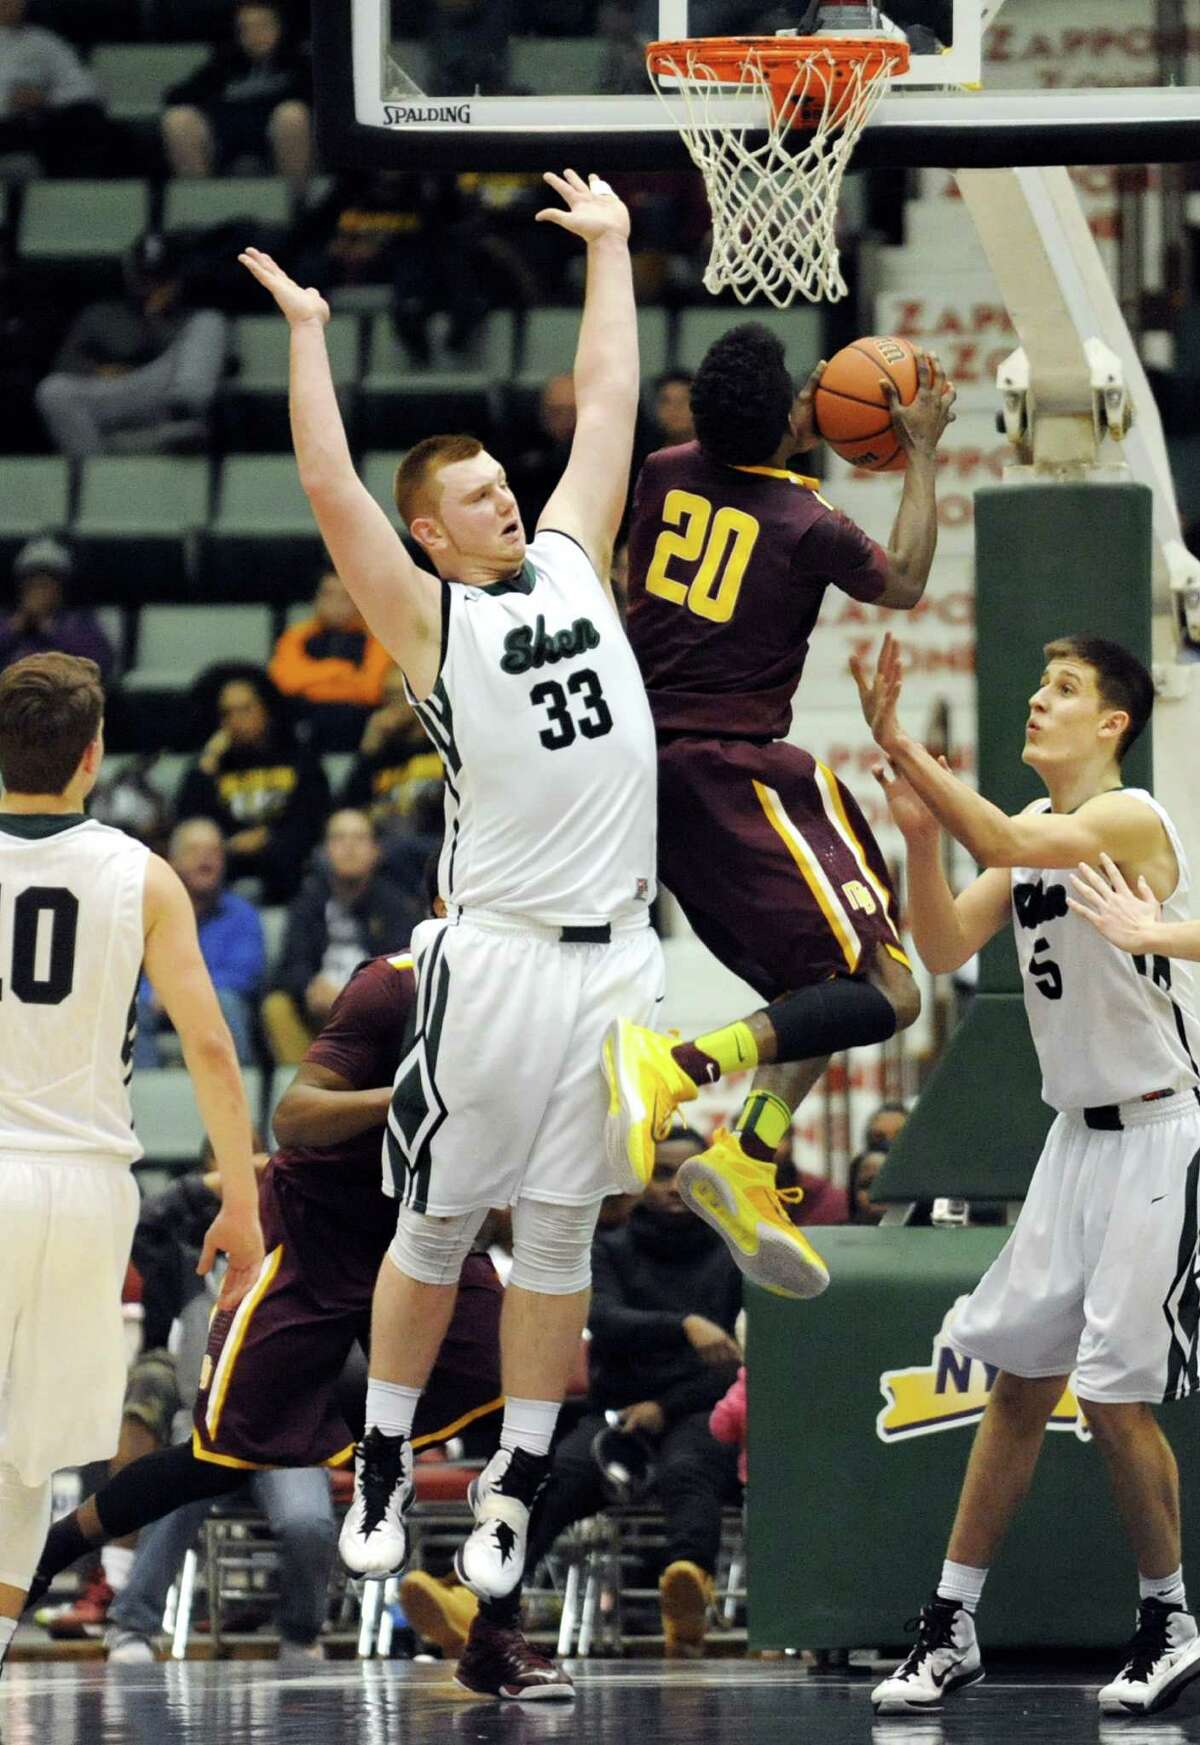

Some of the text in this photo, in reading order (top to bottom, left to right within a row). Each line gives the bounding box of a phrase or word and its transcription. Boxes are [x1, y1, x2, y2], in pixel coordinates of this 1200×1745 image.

[383, 104, 471, 125] SPALDING
[645, 489, 760, 623] 20
[500, 613, 601, 675] Shen
[530, 668, 613, 751] 33
[0, 882, 79, 1005] 0
[1029, 937, 1063, 1000] 5
